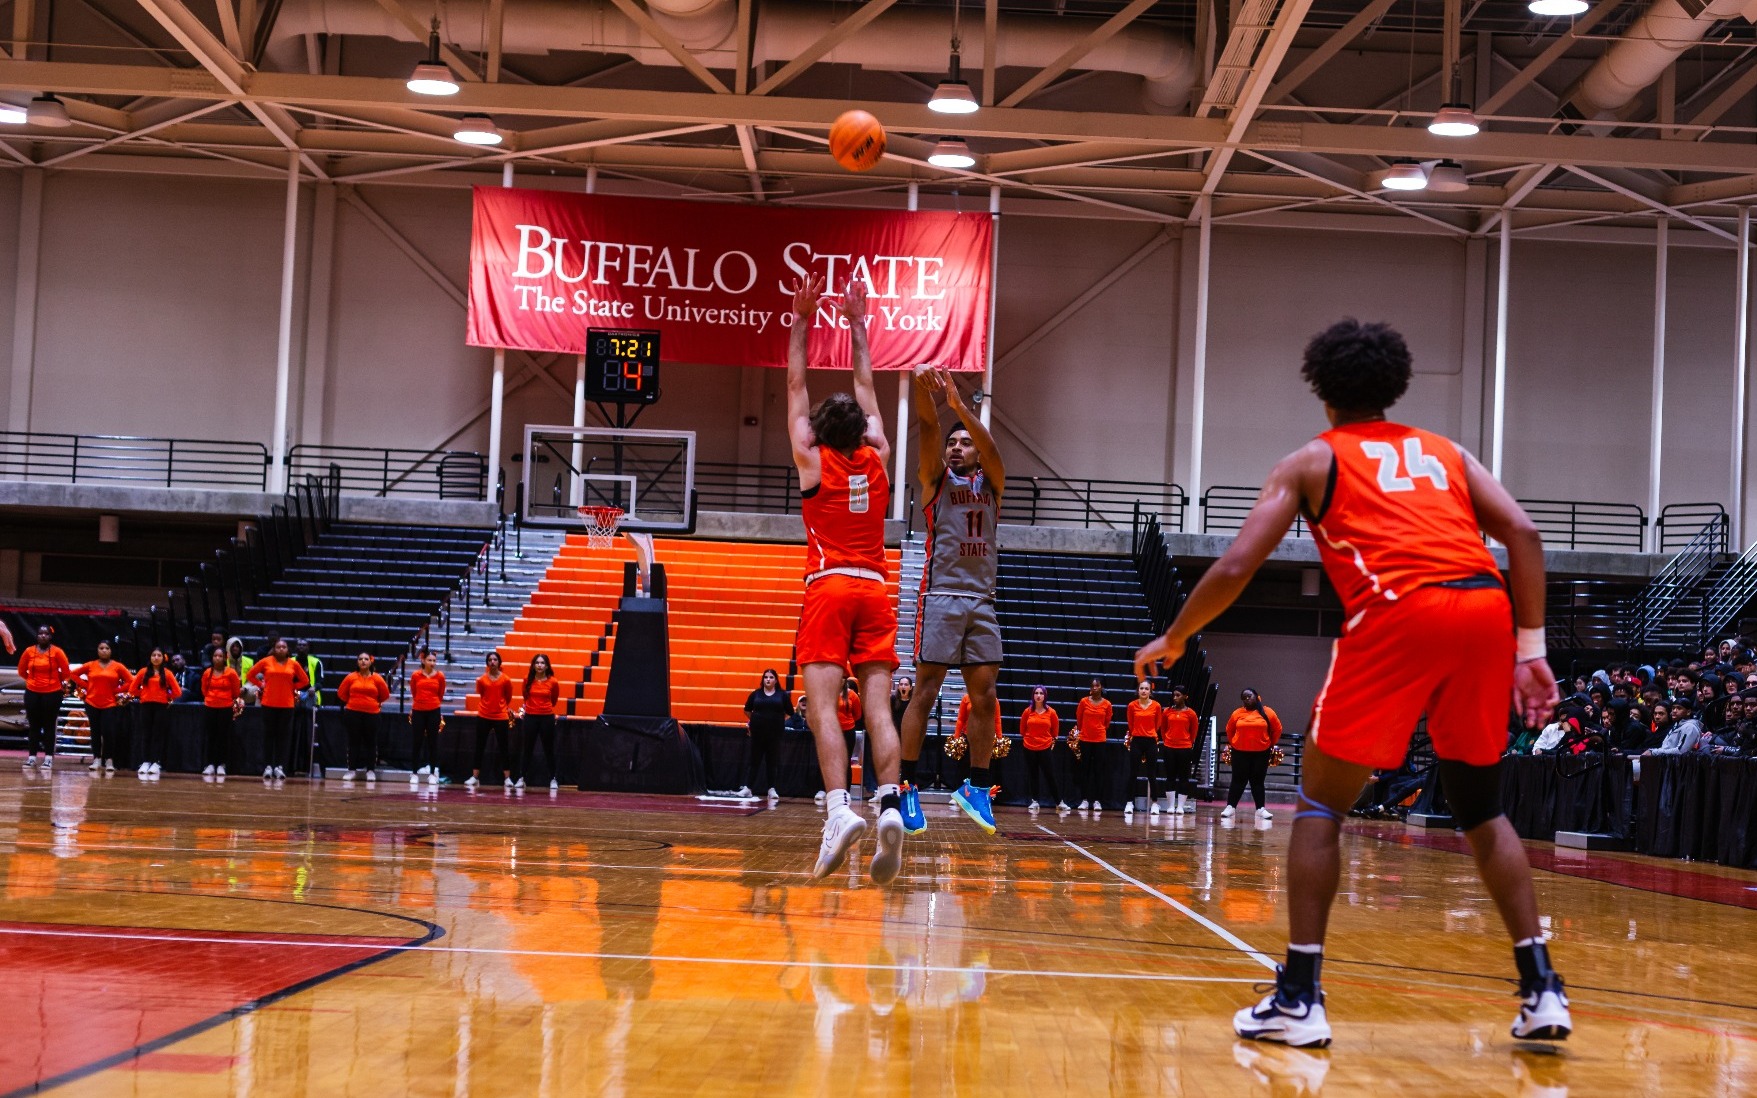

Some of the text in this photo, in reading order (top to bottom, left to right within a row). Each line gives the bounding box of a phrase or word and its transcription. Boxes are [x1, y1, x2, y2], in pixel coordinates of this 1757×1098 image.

[514, 285, 565, 313] The
[572, 290, 634, 318] State
[643, 294, 773, 334] University
[880, 306, 942, 331] York
[610, 339, 651, 358] 7:21
[624, 361, 642, 391] 4
[1359, 437, 1449, 493] 24
[965, 509, 983, 537] 11
[959, 542, 987, 557] STATE
